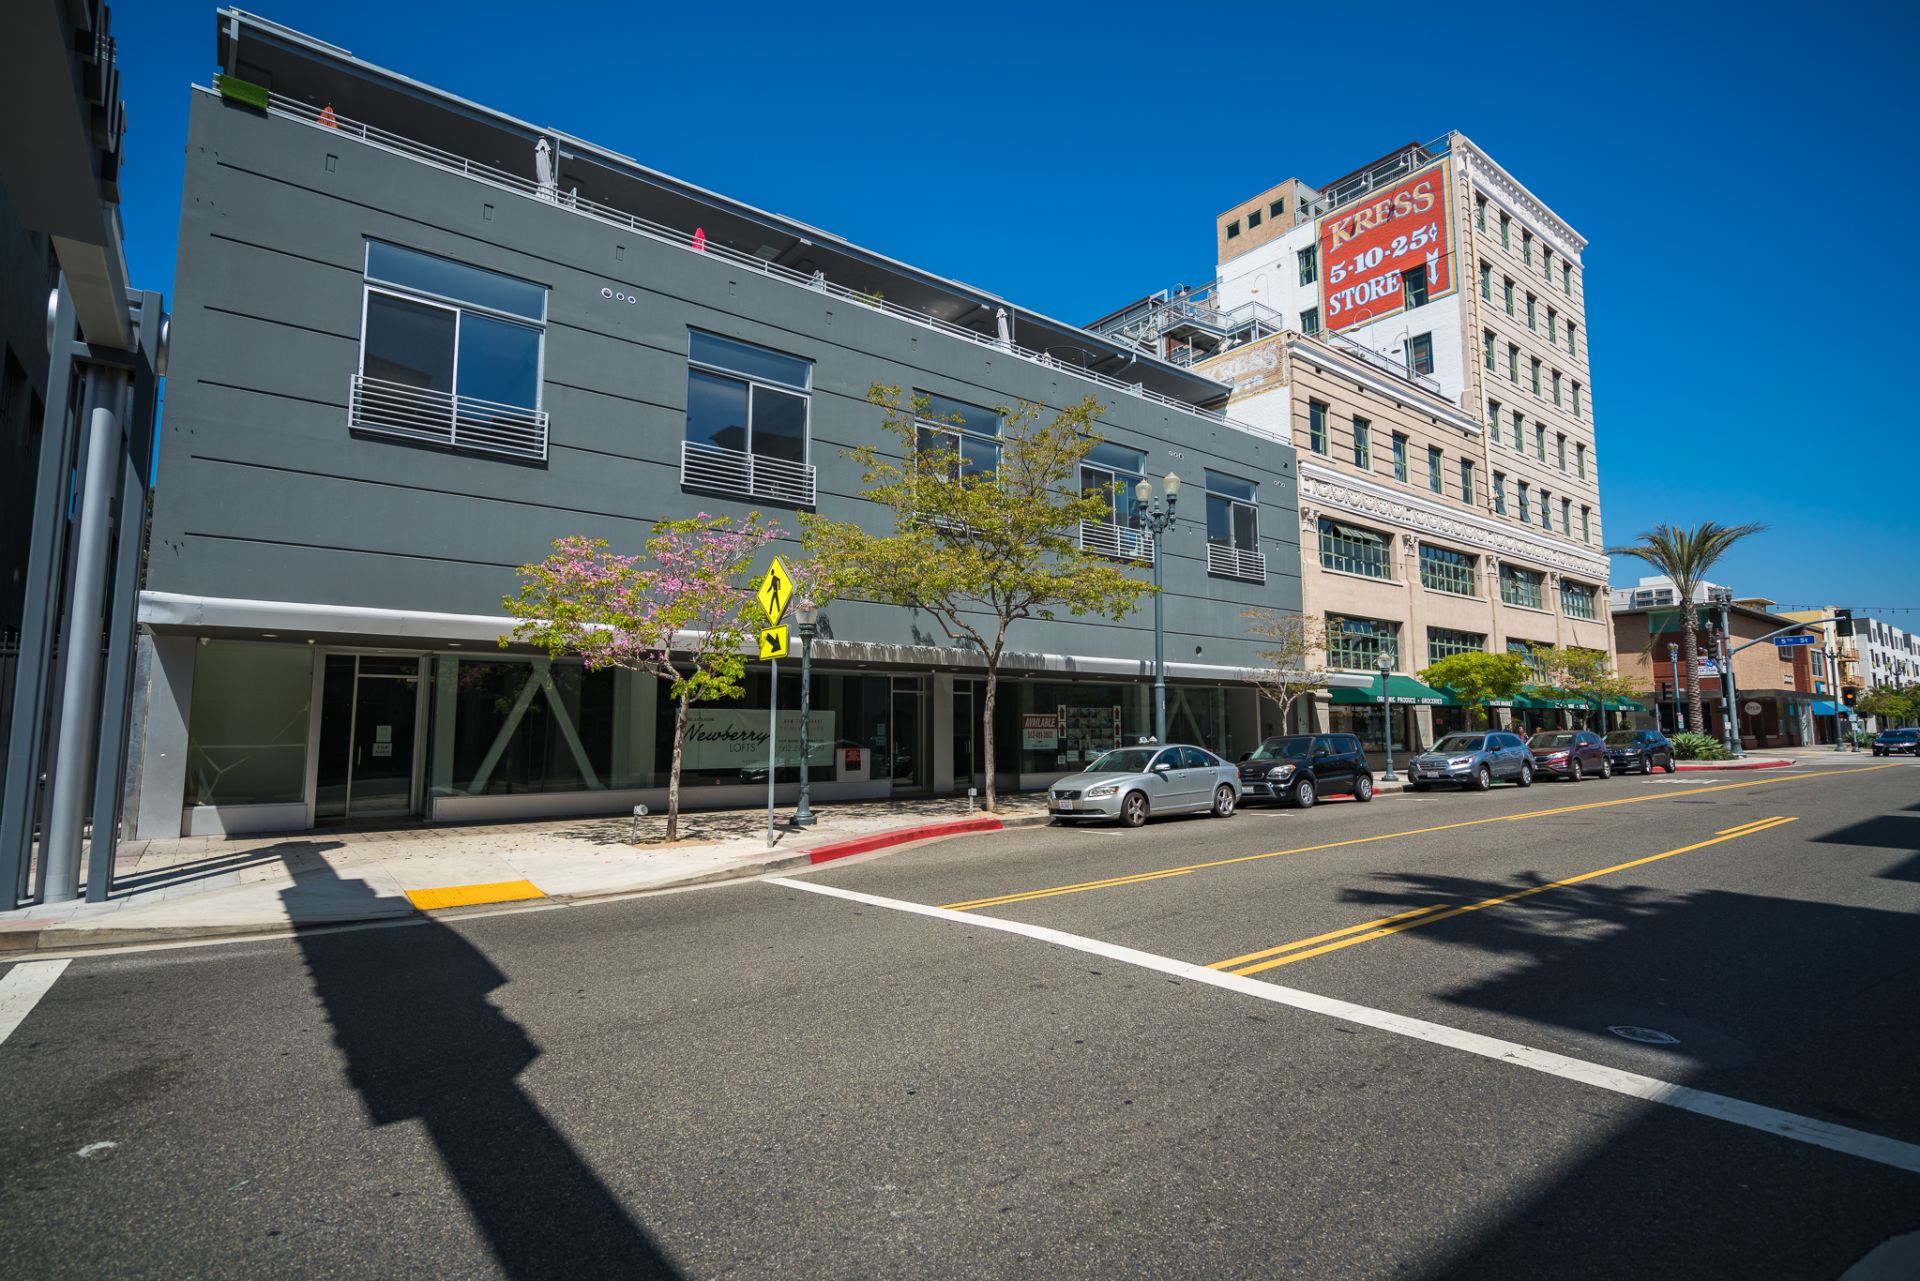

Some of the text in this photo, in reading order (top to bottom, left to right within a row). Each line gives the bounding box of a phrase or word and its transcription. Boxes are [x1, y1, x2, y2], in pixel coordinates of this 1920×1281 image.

[1328, 181, 1435, 254] KRESS
[1329, 268, 1401, 317] STORE
[1397, 696, 1416, 704] PRODUCE
[1024, 717, 1056, 728] AVAILABLE
[683, 723, 771, 746] Newberry
[729, 743, 756, 752] LOFTS
